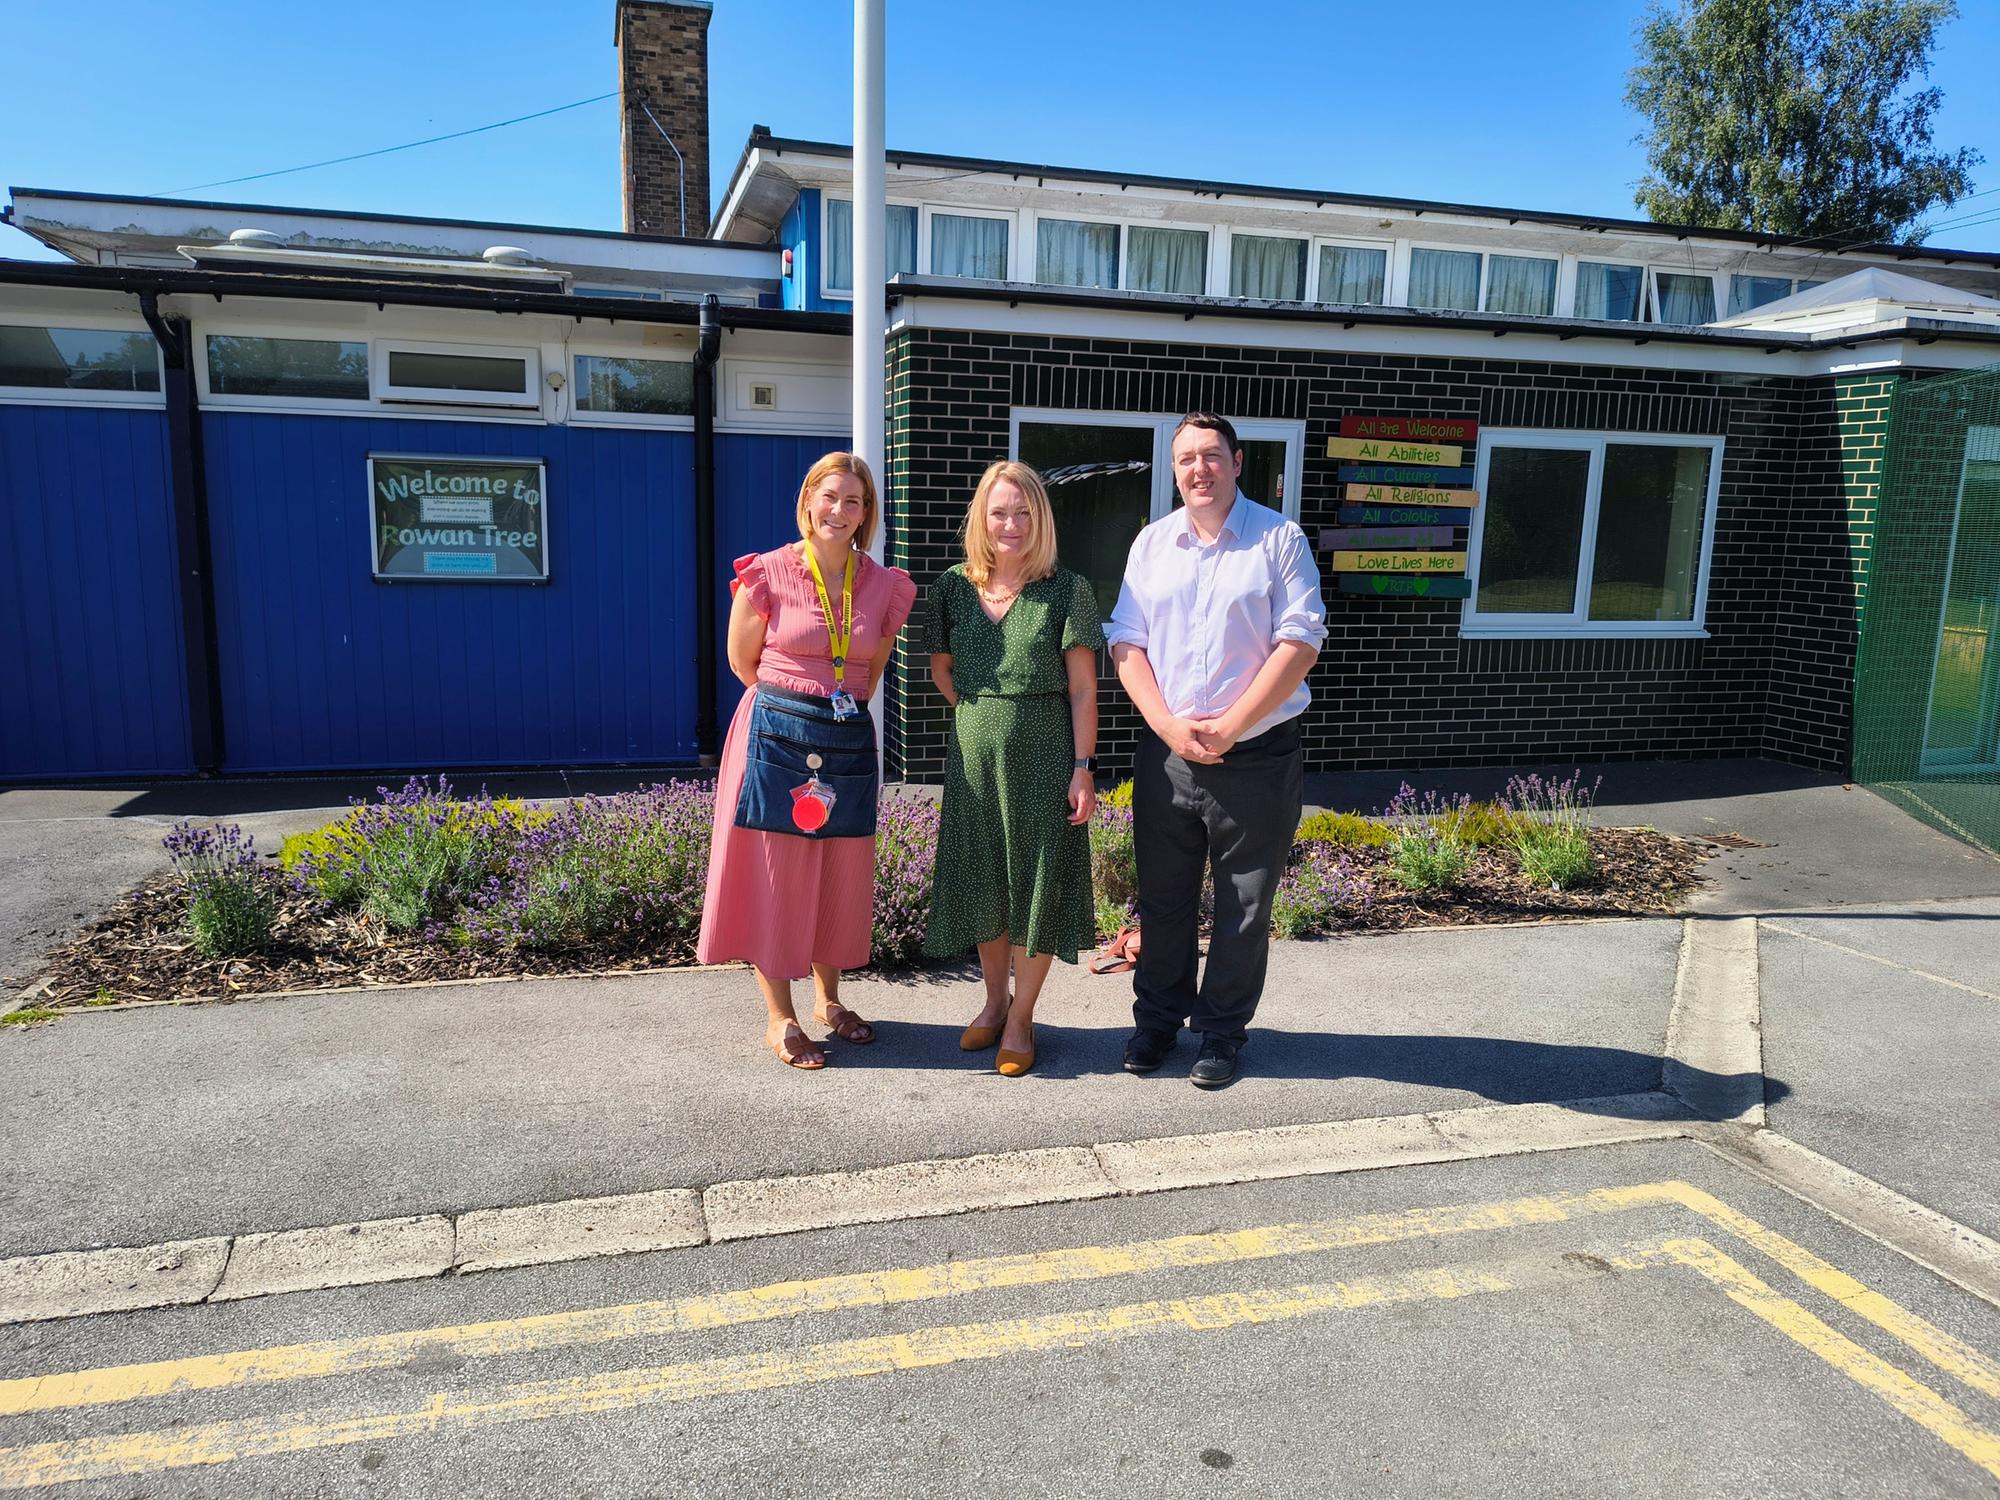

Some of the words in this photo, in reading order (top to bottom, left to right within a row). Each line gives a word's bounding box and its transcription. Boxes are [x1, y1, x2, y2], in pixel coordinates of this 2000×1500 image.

[1357, 421, 1376, 435] All
[1379, 422, 1399, 436] are
[1407, 419, 1465, 438] Welcome
[1359, 443, 1379, 459] All
[1387, 446, 1441, 462] Abilities
[1355, 467, 1376, 481] All
[1383, 467, 1439, 483] Cultures
[377, 470, 508, 503] Welcome
[513, 479, 540, 506] to
[1365, 486, 1382, 500] All
[1391, 487, 1451, 504] Religions
[1361, 509, 1381, 523] All
[1390, 509, 1440, 524] Colours
[381, 524, 476, 546] Rowan
[479, 524, 537, 547] Tree
[1357, 555, 1389, 569] Love
[1392, 556, 1422, 570] Lives
[1428, 556, 1455, 569] Here
